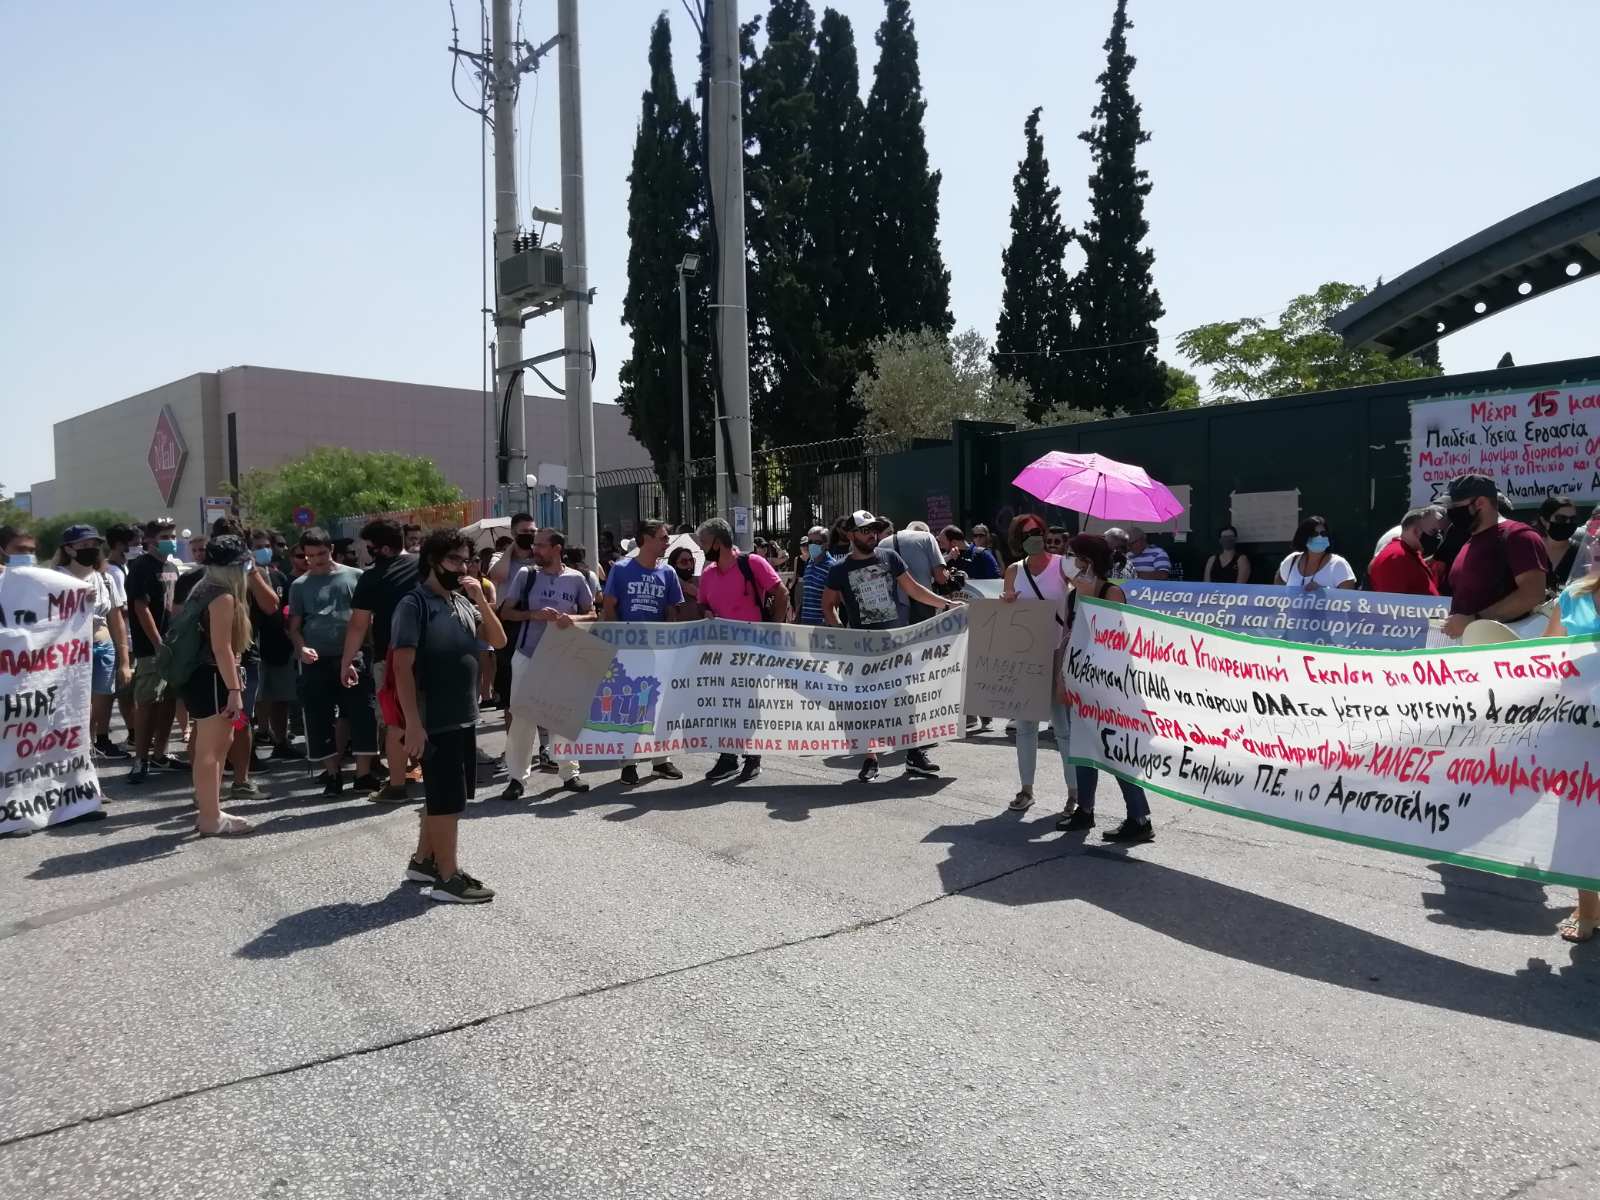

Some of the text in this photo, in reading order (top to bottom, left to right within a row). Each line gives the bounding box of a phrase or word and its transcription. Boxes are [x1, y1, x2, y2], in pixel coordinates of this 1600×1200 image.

[1471, 389, 1600, 423] Μέχρι 15 μα
[1482, 425, 1518, 447] Υγεία
[1525, 419, 1588, 443] Εργασία
[1522, 441, 1579, 462] διορισμοί
[1573, 460, 1590, 471] και
[1507, 476, 1583, 498] Αναπληρωτών
[627, 582, 666, 597] STATE
[1139, 586, 1193, 604] Άμεσα
[1196, 590, 1248, 609] μέτρα
[1253, 594, 1351, 612] ασφάλειας
[1358, 598, 1371, 613] &
[655, 624, 796, 648] ΕΚΠΑΙΔΕΥΤΙΚΩΝ
[982, 609, 1035, 654] 15
[1241, 614, 1268, 627] και
[1274, 612, 1374, 636] λειτουργία
[1381, 624, 1421, 639] των
[700, 643, 951, 676] ΜΗ ΣΥΓΧΩΝΕΥΕΤΕ ΤΑ ΟΝΕΙΡΑ ΜΑΣ
[1129, 625, 1189, 666] Δημόσια
[1190, 635, 1289, 682] Υποχρεωτική
[1383, 669, 1408, 686] για
[1412, 658, 1453, 685] ΟΛΑ
[1454, 669, 1479, 685] τα
[1493, 651, 1581, 679] Παιδιά
[671, 678, 690, 690] ΟΧΙ
[696, 676, 725, 688] ΣΤΗΝ
[731, 678, 799, 690] ΑΞΙΟΛΟΓΗΣΗ
[805, 680, 824, 690] ΚΑΙ
[827, 682, 848, 693] ΣΤΟ
[855, 680, 902, 693] ΣΧΟΛΕΙΟ
[905, 673, 927, 686] ΤΗΣ
[0, 685, 58, 722] ΗΤΑΣ
[697, 688, 943, 711] ΟΧΙ ΣΤΗ ΔΙΑΛΥΣΗ ΤΟΥ ΔΗΜΟΣΙΟΥ ΣΧΟΛΕΙΟΥ
[1174, 688, 1193, 705] να
[1196, 688, 1248, 714] πάρουν
[1253, 691, 1298, 717] ΟΛΑ
[1298, 703, 1327, 717] τα
[1332, 696, 1390, 722] μέτρα
[1397, 696, 1477, 724] υγιεινής
[1485, 688, 1502, 723] &
[666, 718, 737, 731] ΠΑΙΔΑΓΩΓΙΚΗ
[743, 719, 803, 731] ΕΛΕΥΘΕΡΙΑ
[806, 720, 825, 731] ΚΑΙ
[828, 716, 903, 732] ΔΗΜΟΚΡΑΤΙΑ
[908, 712, 927, 725] ΣΤΑ
[16, 725, 82, 759] ΟΛΟΥΣ
[553, 743, 625, 755] ΚΑΝΕΝΑΣ
[718, 737, 783, 750] ΚΑΝΕΝΑΣ
[787, 738, 859, 751] ΜΑΘΗΤΗΣ
[868, 735, 897, 749] ΔΕΝ
[901, 723, 959, 746] ΠΕΡΙΣΣΕ
[1100, 727, 1172, 780] Σύλλογος
